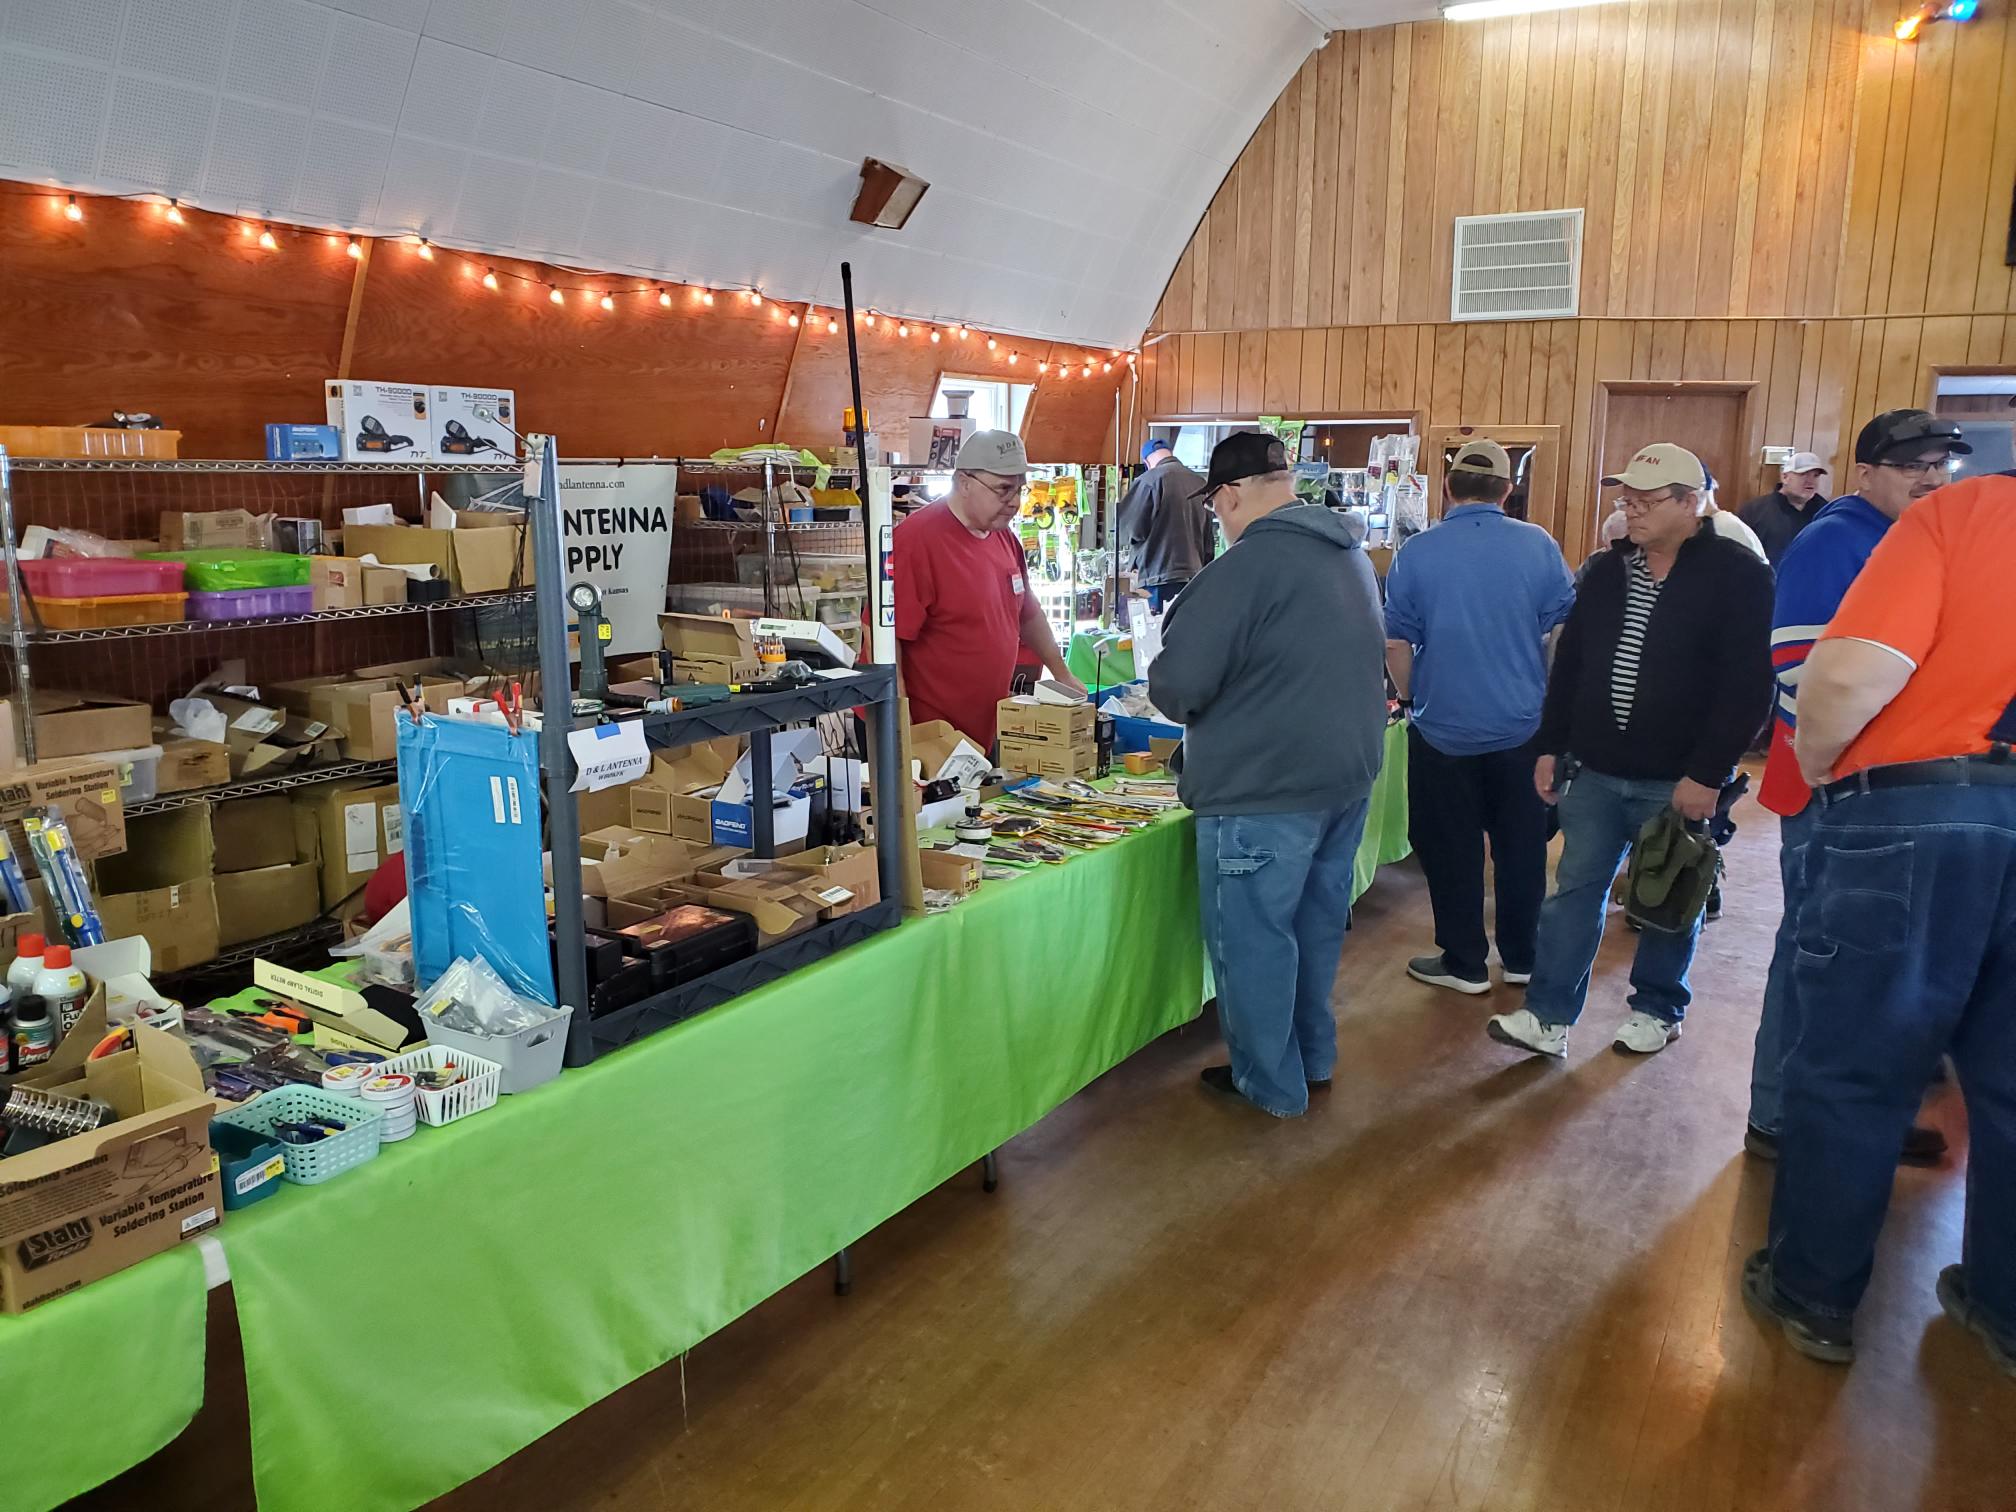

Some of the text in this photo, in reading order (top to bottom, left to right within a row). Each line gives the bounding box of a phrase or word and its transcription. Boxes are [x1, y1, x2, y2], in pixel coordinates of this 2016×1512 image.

[563, 506, 668, 537] NTENNA
[567, 543, 624, 574] PPLY
[36, 768, 115, 790] Variable Temperature
[592, 766, 599, 774] &
[606, 756, 643, 772] ANTENNA
[46, 781, 109, 800] Soldering Station
[270, 973, 323, 998] DIGITAL CLAMP METER
[99, 1199, 145, 1228] Variable
[148, 1173, 214, 1206] Temperature
[114, 1208, 165, 1238] Soldering
[169, 1191, 205, 1214] Station
[24, 1217, 93, 1260] Stahl
